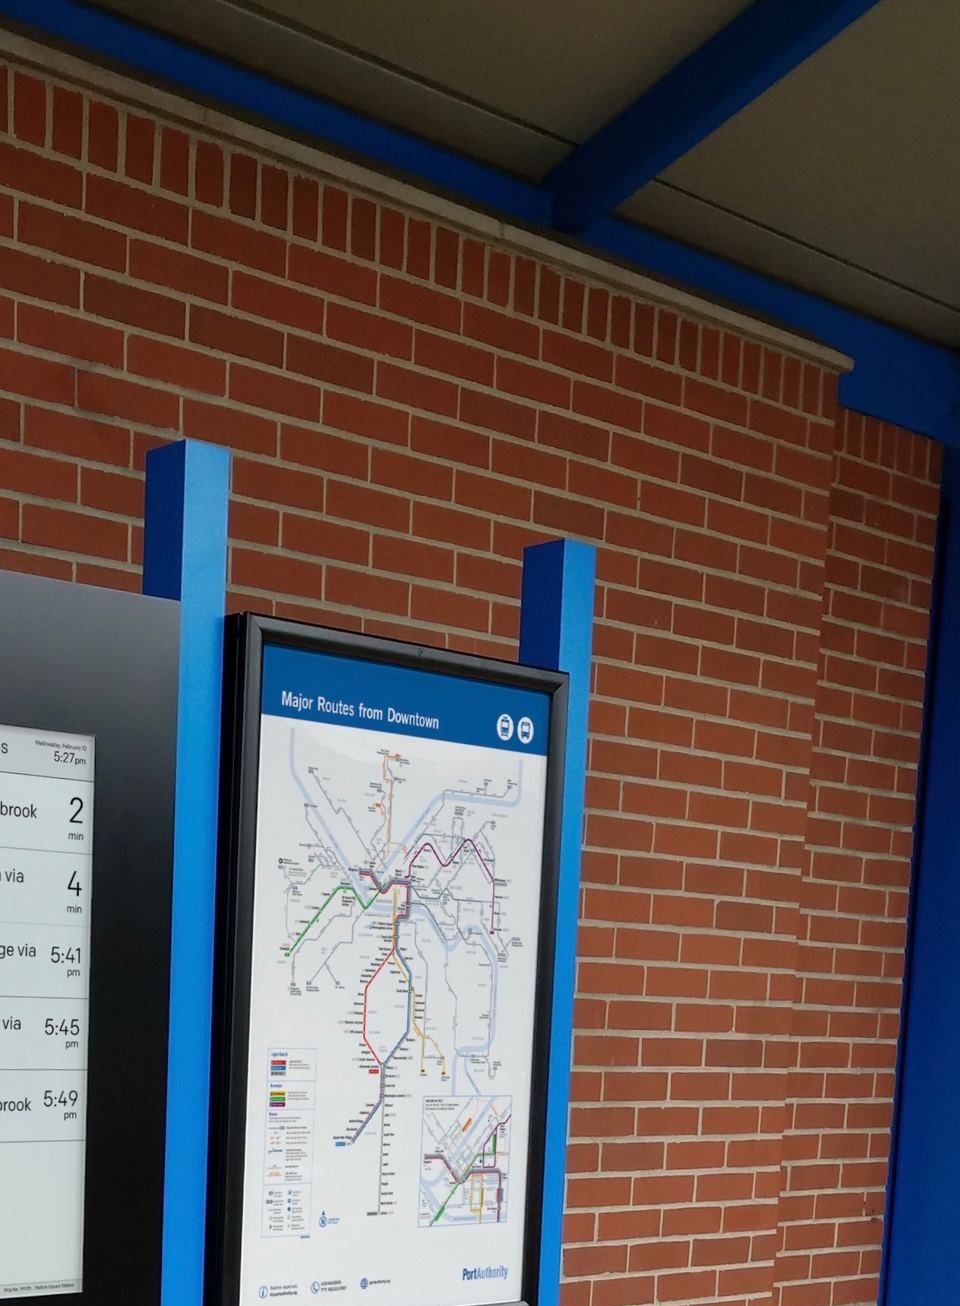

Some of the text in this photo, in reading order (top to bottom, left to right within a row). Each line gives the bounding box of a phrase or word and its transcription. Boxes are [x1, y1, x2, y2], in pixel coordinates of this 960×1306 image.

[281, 690, 439, 730] Major Routes from Downtown
[69, 797, 84, 824] 2
[68, 831, 84, 841] min
[5, 867, 24, 883] via
[67, 870, 83, 897] 4
[66, 904, 82, 914] min
[17, 943, 37, 957] via
[50, 946, 81, 964] 5:41
[67, 968, 80, 978] pm
[2, 1016, 22, 1030] via
[44, 1018, 80, 1036] 5:45
[65, 1040, 79, 1050] pm
[43, 1090, 78, 1107] 5:49
[64, 1111, 77, 1121] pm
